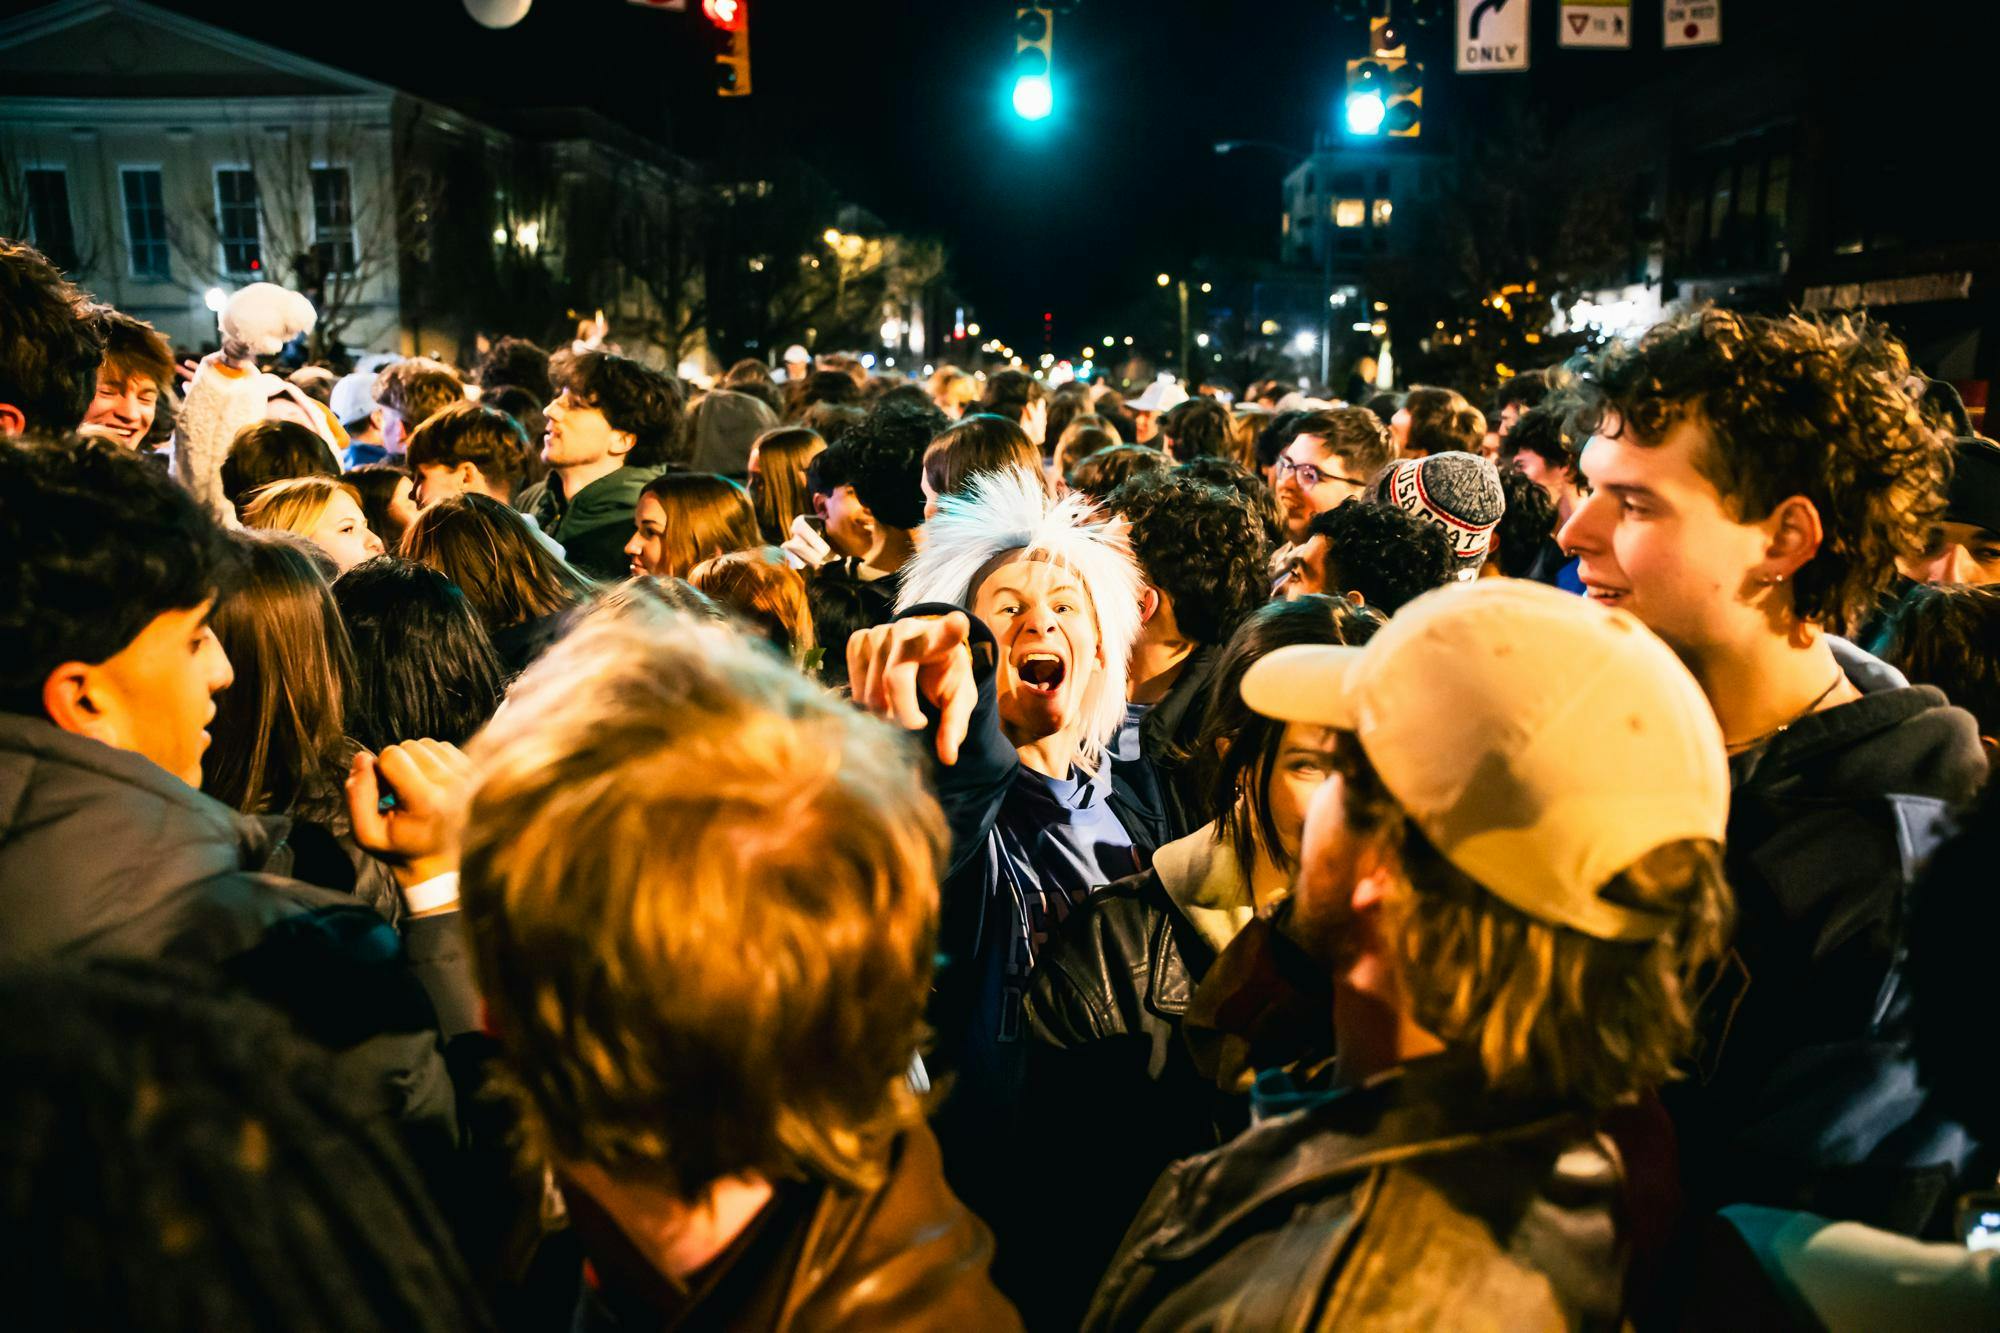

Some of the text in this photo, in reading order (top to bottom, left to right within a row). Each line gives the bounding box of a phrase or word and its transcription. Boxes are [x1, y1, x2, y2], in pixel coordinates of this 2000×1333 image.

[1667, 6, 1715, 22] ON RED
[1466, 44, 1519, 63] ONLY
